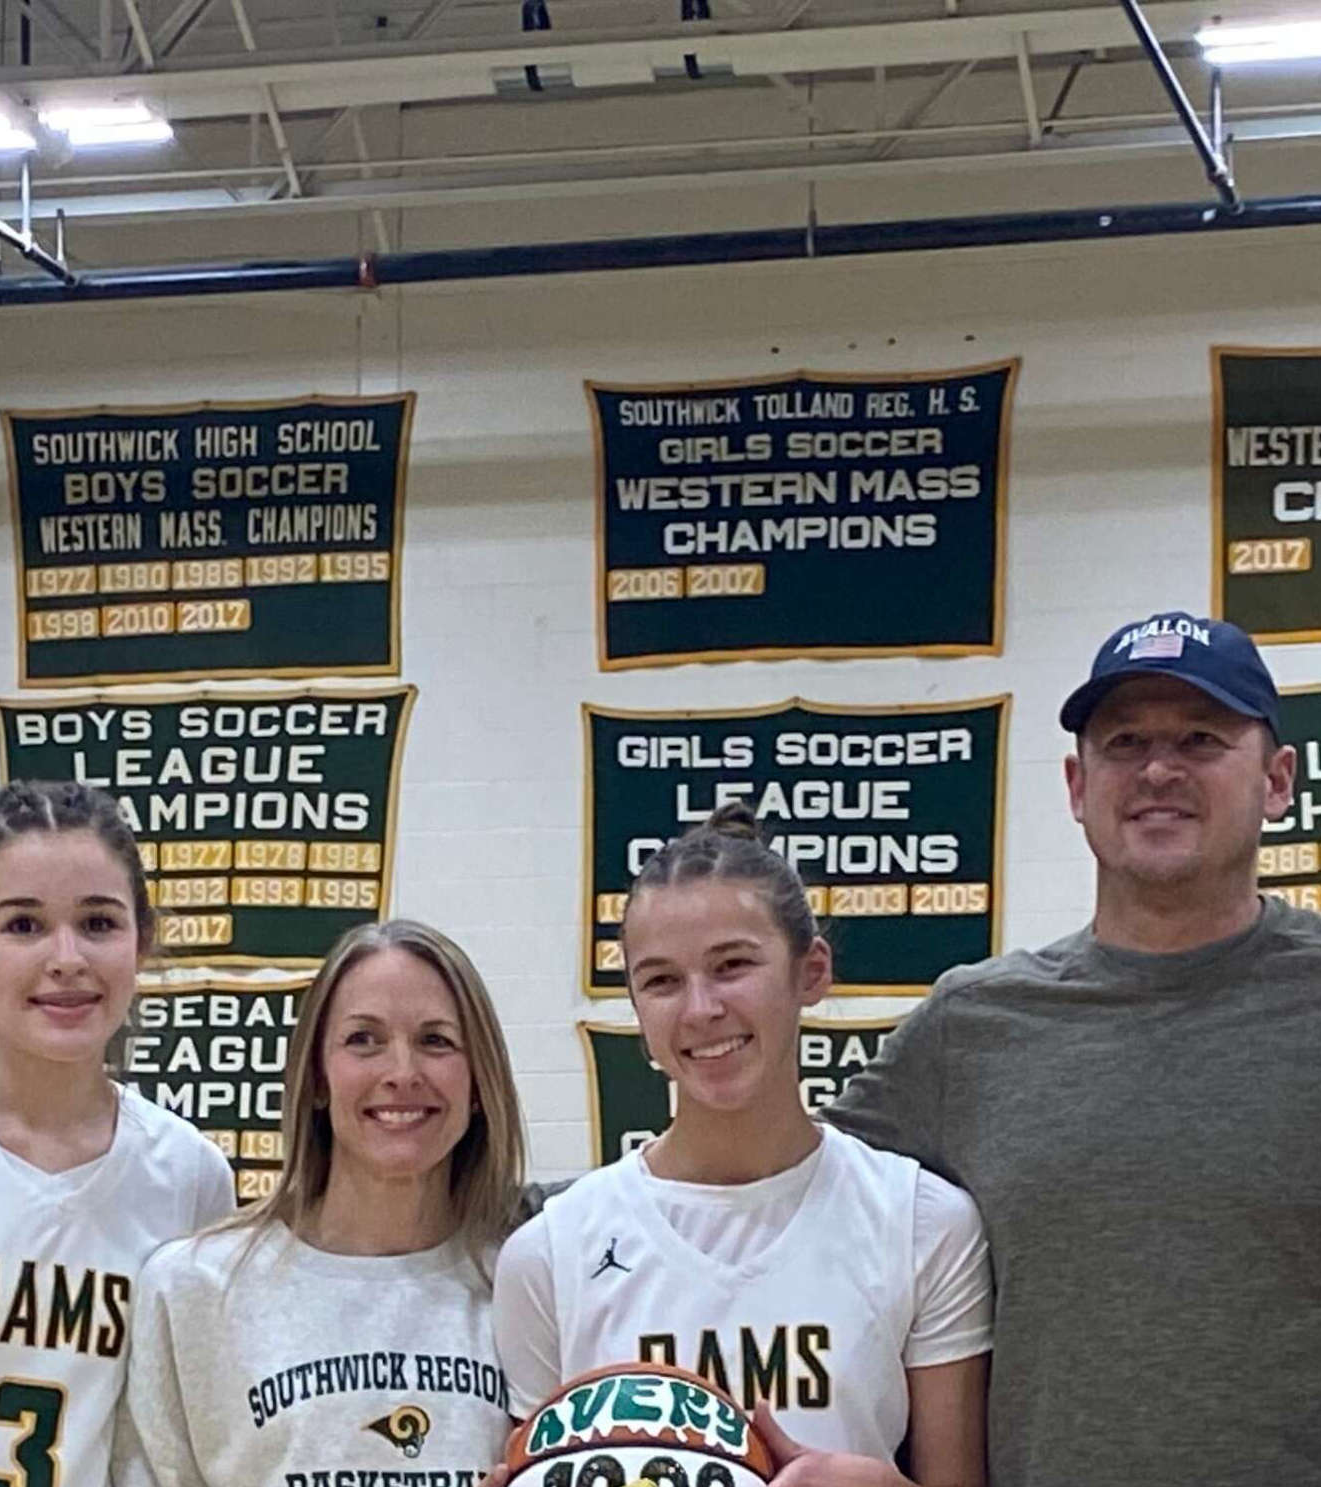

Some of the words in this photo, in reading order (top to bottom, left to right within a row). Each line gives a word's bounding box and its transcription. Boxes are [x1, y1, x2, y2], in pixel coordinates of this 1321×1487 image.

[620, 398, 740, 427] SOUTHWICK
[754, 392, 854, 421] TOLLAND
[866, 390, 916, 419] REG.
[929, 387, 950, 416] H.
[959, 385, 980, 414] S.
[33, 429, 180, 466] SOUTHWICK
[194, 425, 259, 460] HIGH
[278, 419, 381, 456] SCHOOL
[658, 432, 773, 466] GIRLS
[787, 427, 944, 460] SOCCER
[64, 468, 167, 506] BOYS
[191, 461, 350, 502] SOCCER
[615, 471, 838, 511] WESTERN
[850, 464, 980, 504] MASS
[39, 510, 143, 555] WESTERN
[159, 507, 229, 551] MASS.
[247, 502, 378, 547] CHAMPIONS
[663, 513, 937, 556] CHAMPIONS
[28, 567, 95, 597] 1977
[175, 560, 241, 590] 1986
[249, 555, 315, 585] 1992
[321, 551, 389, 582] 1995
[1234, 541, 1306, 572] 2017
[612, 569, 679, 598] 2006
[689, 565, 760, 594] 2007
[104, 604, 168, 635] 2010
[181, 600, 249, 630] 2017
[1113, 619, 1210, 654] AVALON
[17, 708, 153, 746] BOYS
[179, 702, 389, 739] SOCCER
[73, 744, 326, 789] LEAGUE
[617, 733, 754, 770] GIRLS
[775, 727, 973, 768] SOCCER
[116, 790, 370, 833] AMPIONS
[161, 843, 231, 871] 1977
[627, 833, 959, 876] CPIONS
[1258, 842, 1315, 873] 986
[160, 877, 228, 907] 1992
[235, 877, 303, 906] 1993
[308, 878, 376, 907] 1995
[832, 886, 905, 915] 2003
[913, 884, 986, 913] 2005
[162, 916, 231, 945] 2017
[126, 1036, 289, 1073] EAGU
[247, 1351, 406, 1430] SOUTHWICK
[415, 1354, 510, 1415] REGION
[528, 1376, 750, 1454] AVERY
